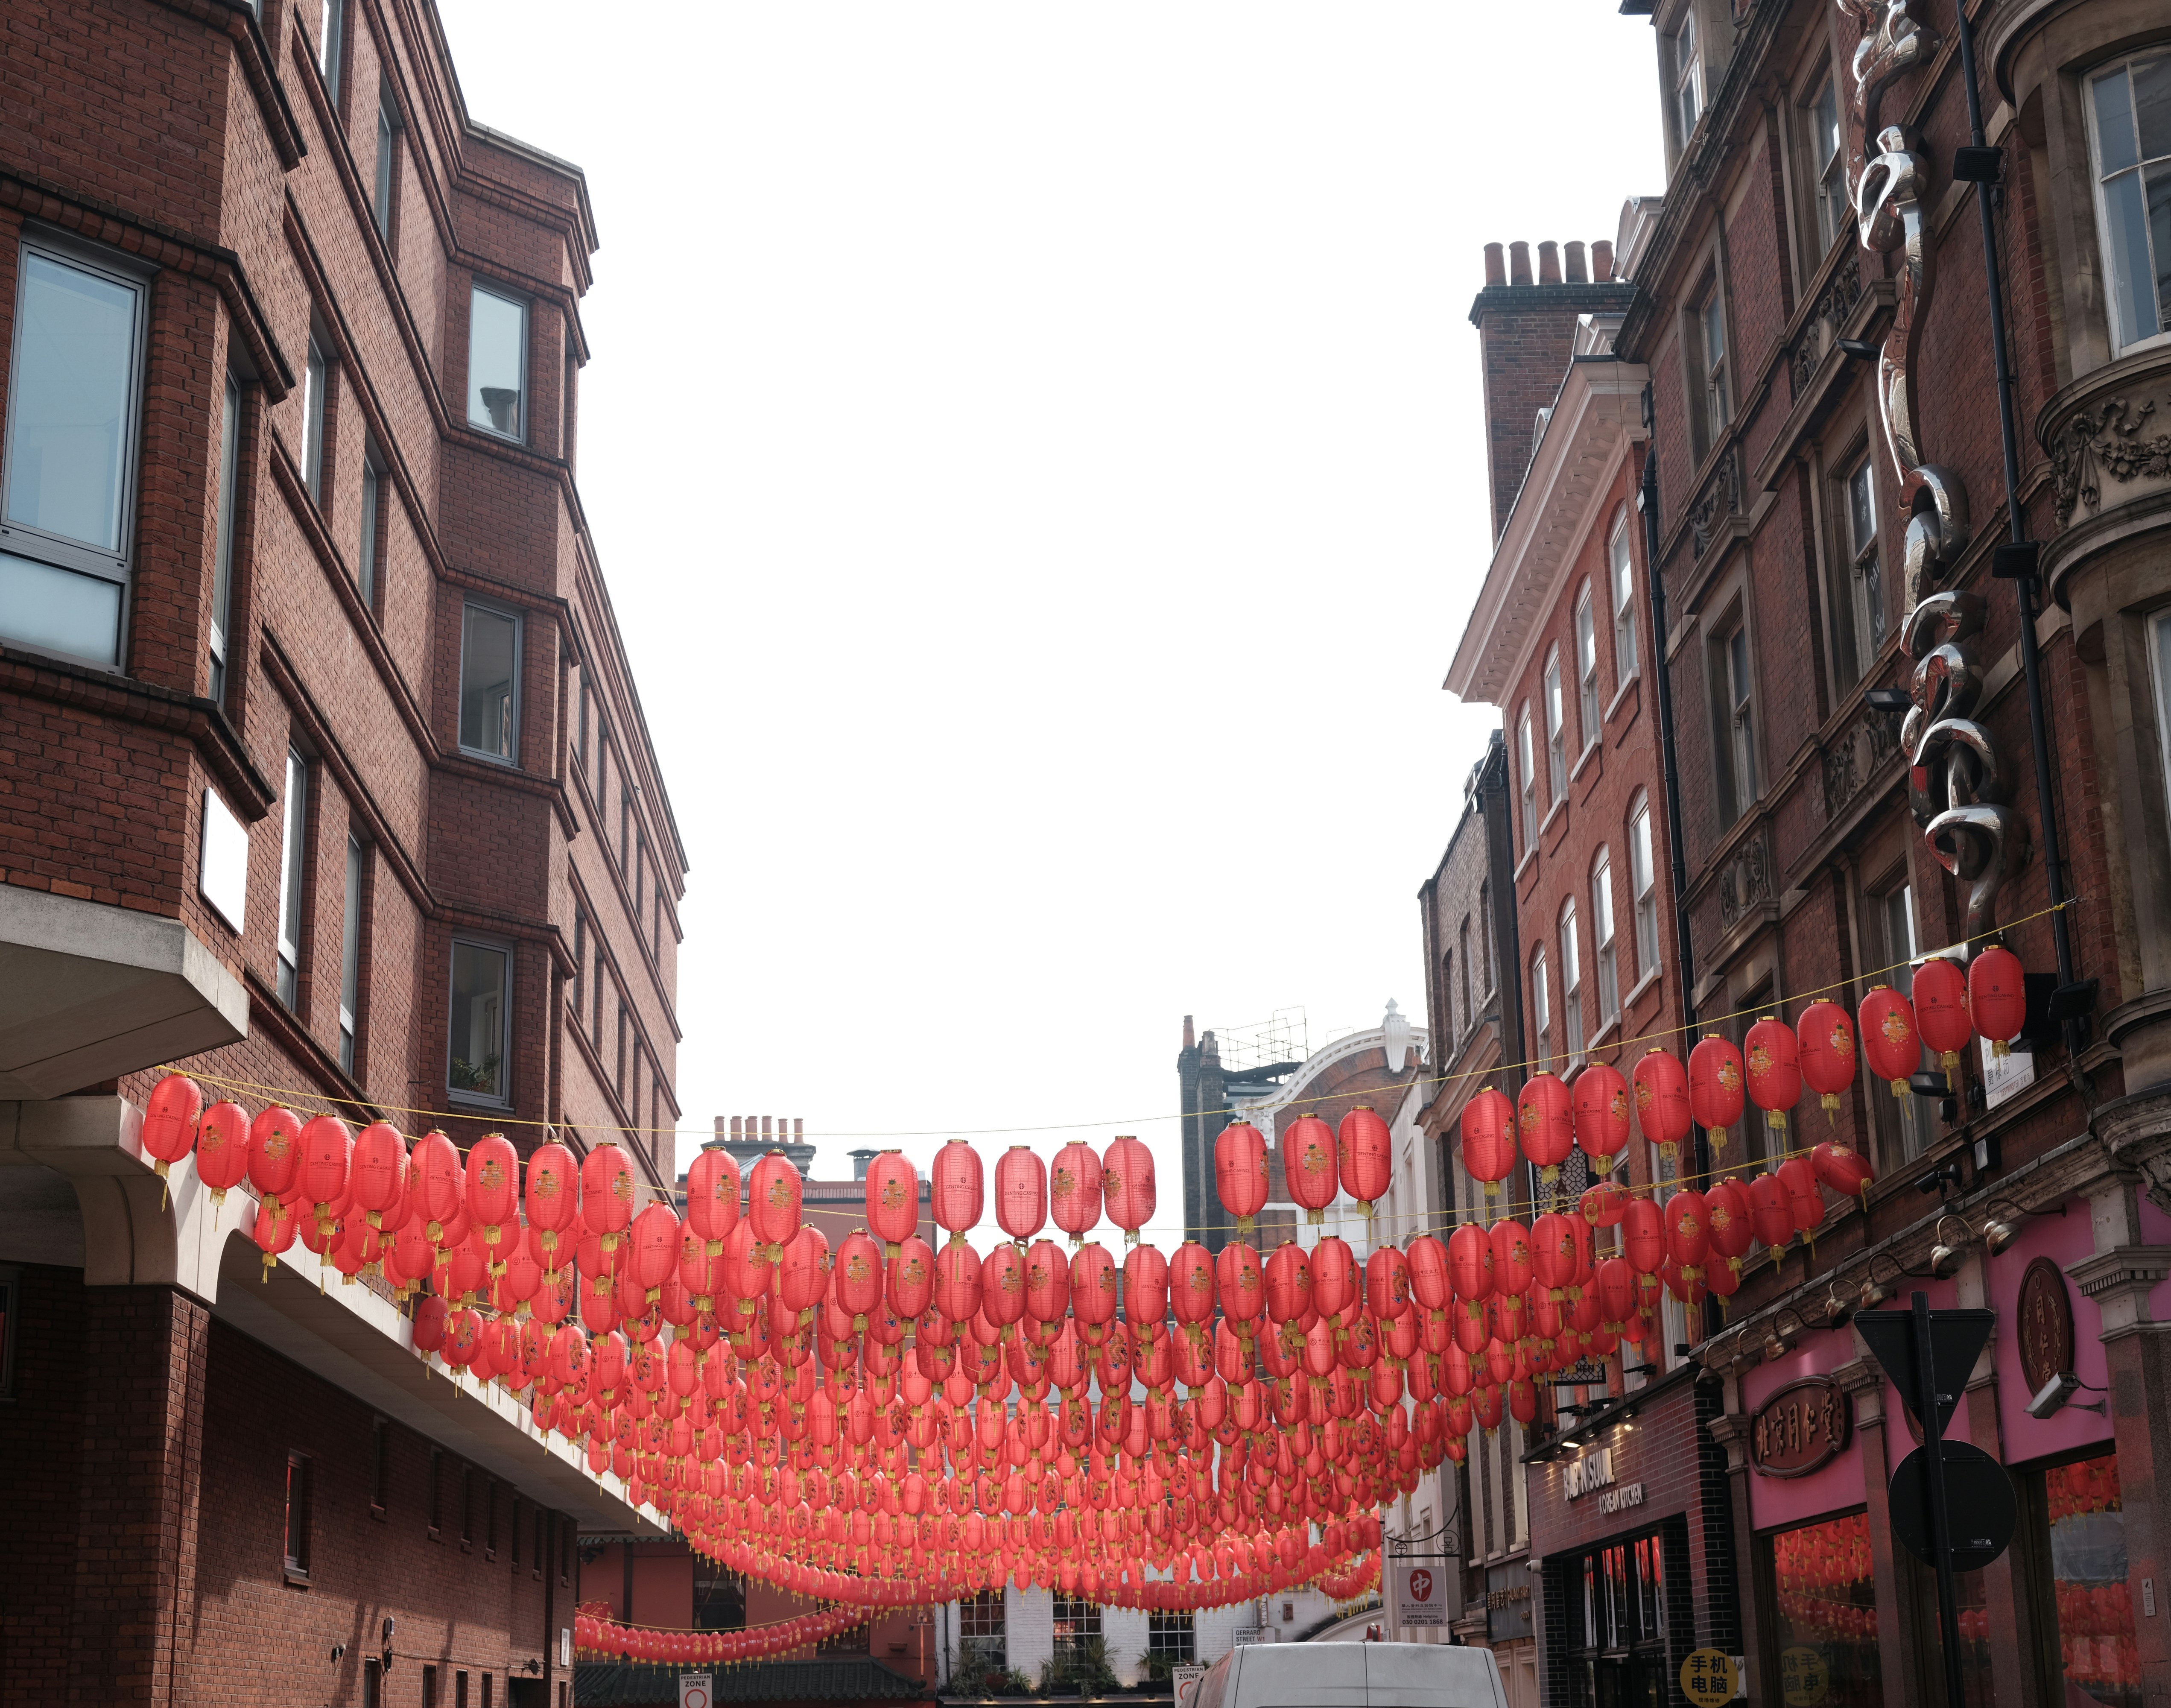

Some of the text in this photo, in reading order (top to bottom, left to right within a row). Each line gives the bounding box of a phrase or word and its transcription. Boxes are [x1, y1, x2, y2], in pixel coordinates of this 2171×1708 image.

[2000, 1079, 2019, 1097] WESTMINSTER
[1598, 1482, 1642, 1515] KOREAN KITCHEN
[1413, 1573, 1430, 1599] 中
[1690, 1655, 1727, 1673] 手机
[1691, 1675, 1727, 1694] 电脑
